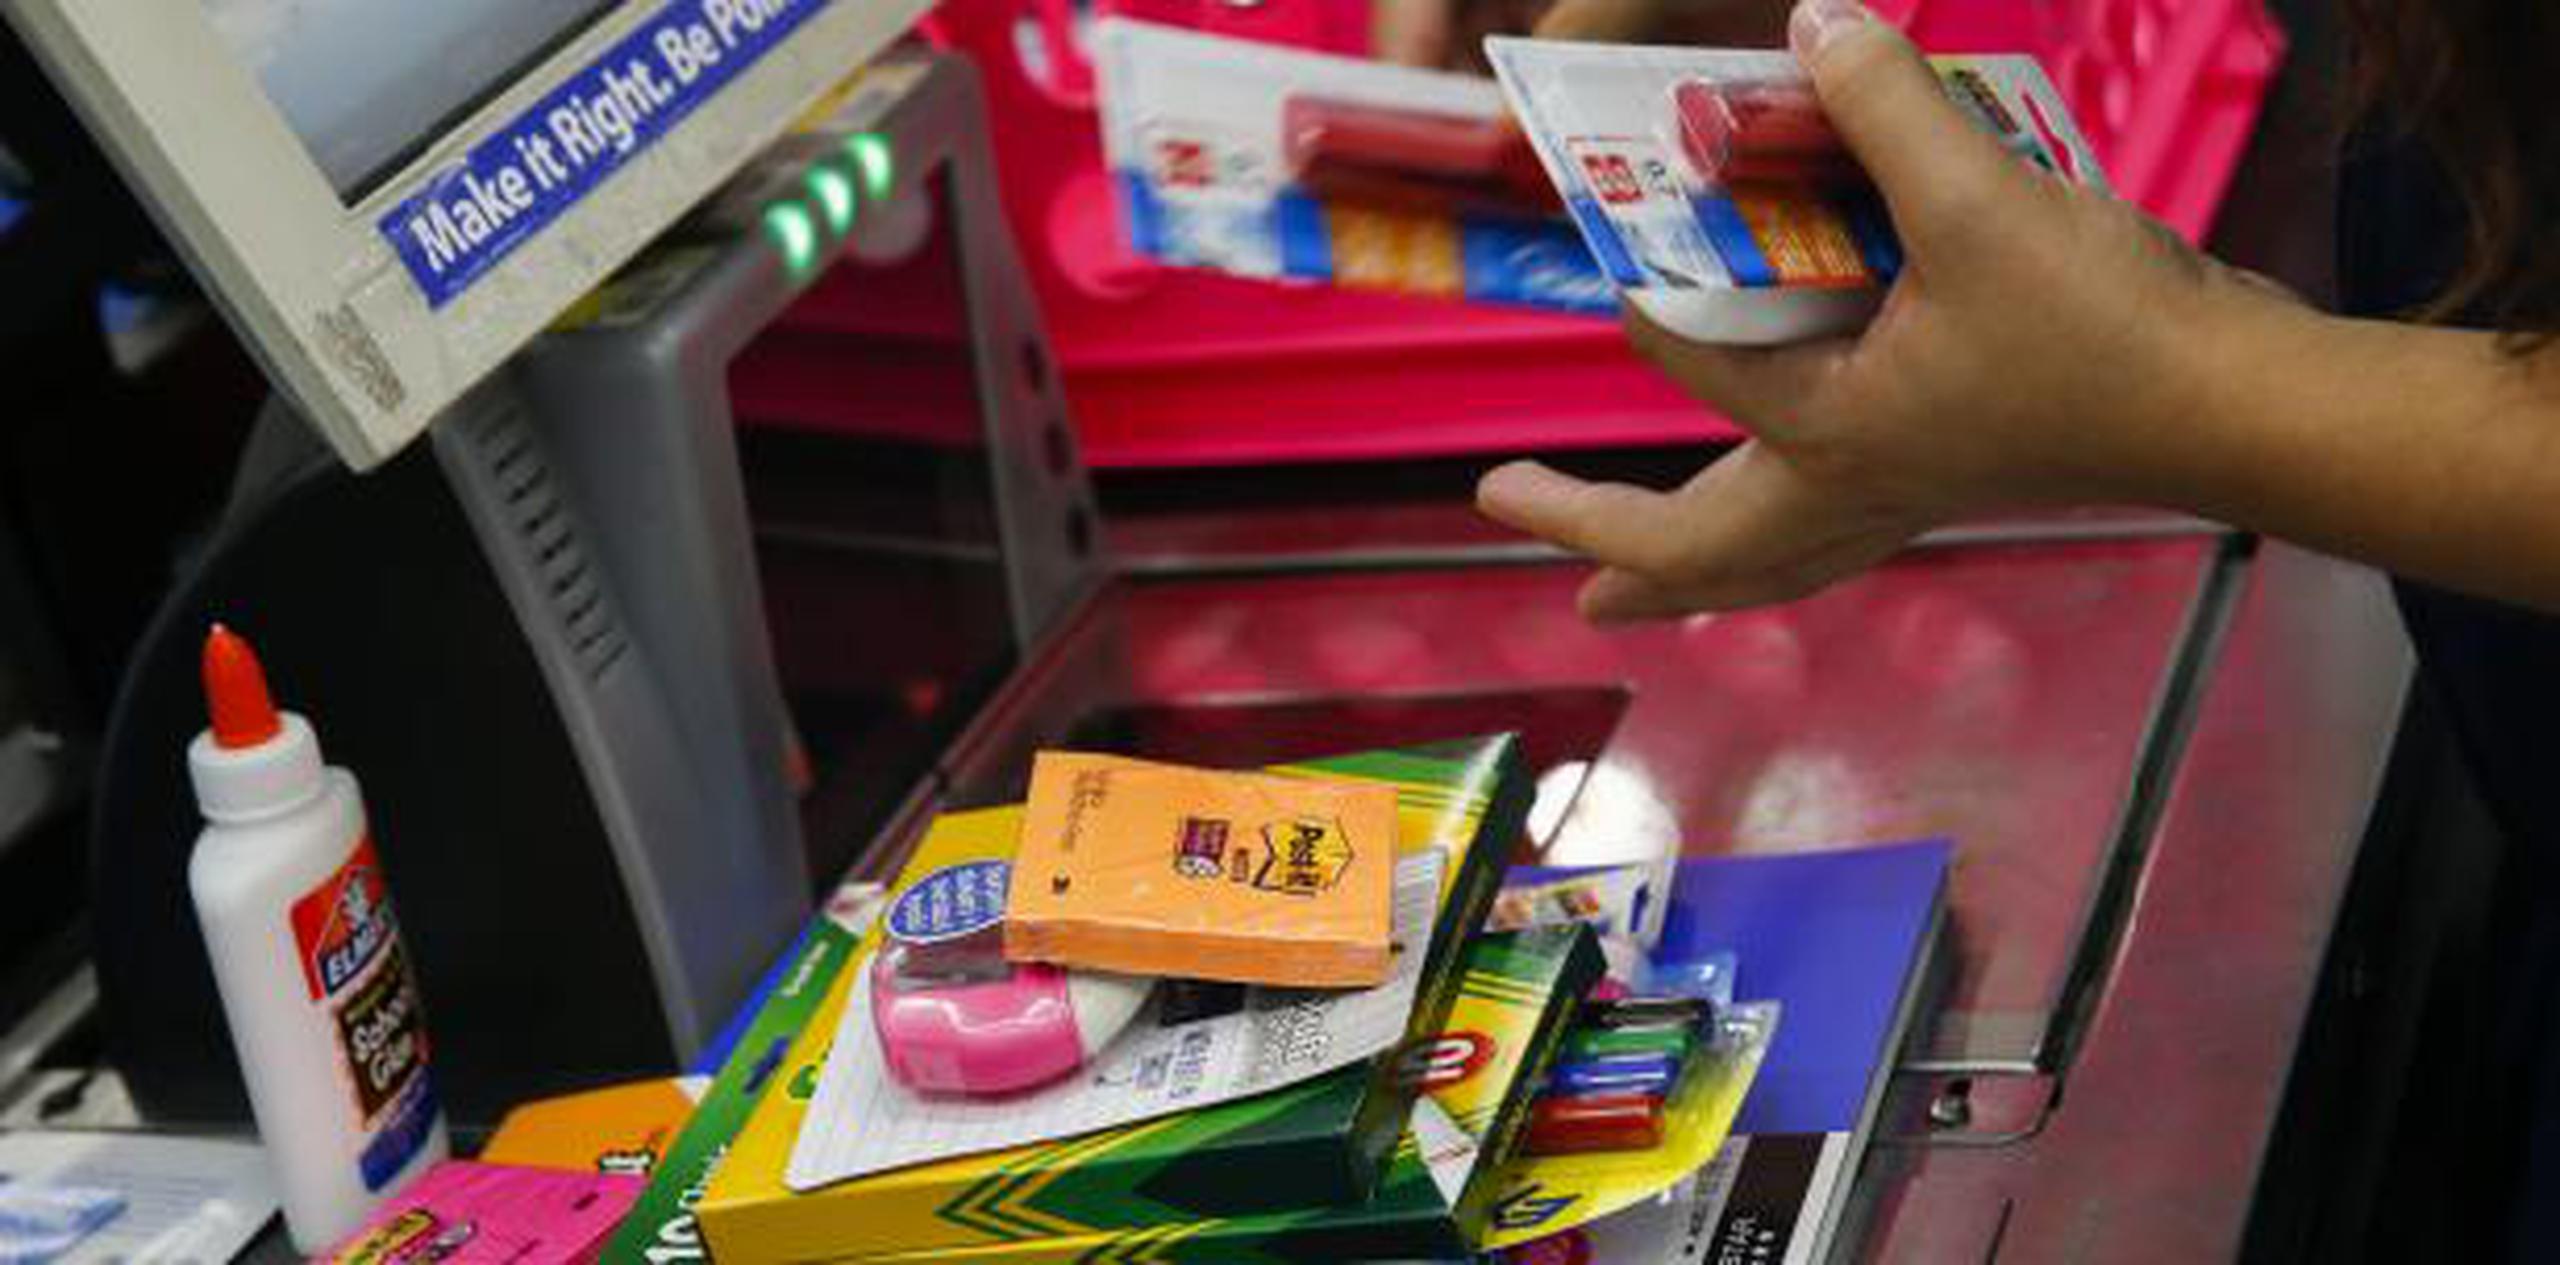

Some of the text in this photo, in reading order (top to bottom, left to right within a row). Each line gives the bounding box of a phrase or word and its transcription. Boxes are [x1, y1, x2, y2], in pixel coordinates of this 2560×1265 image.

[409, 171, 535, 273] Make
[514, 134, 569, 190] it
[548, 60, 675, 167] Right.
[655, 24, 721, 84] Be
